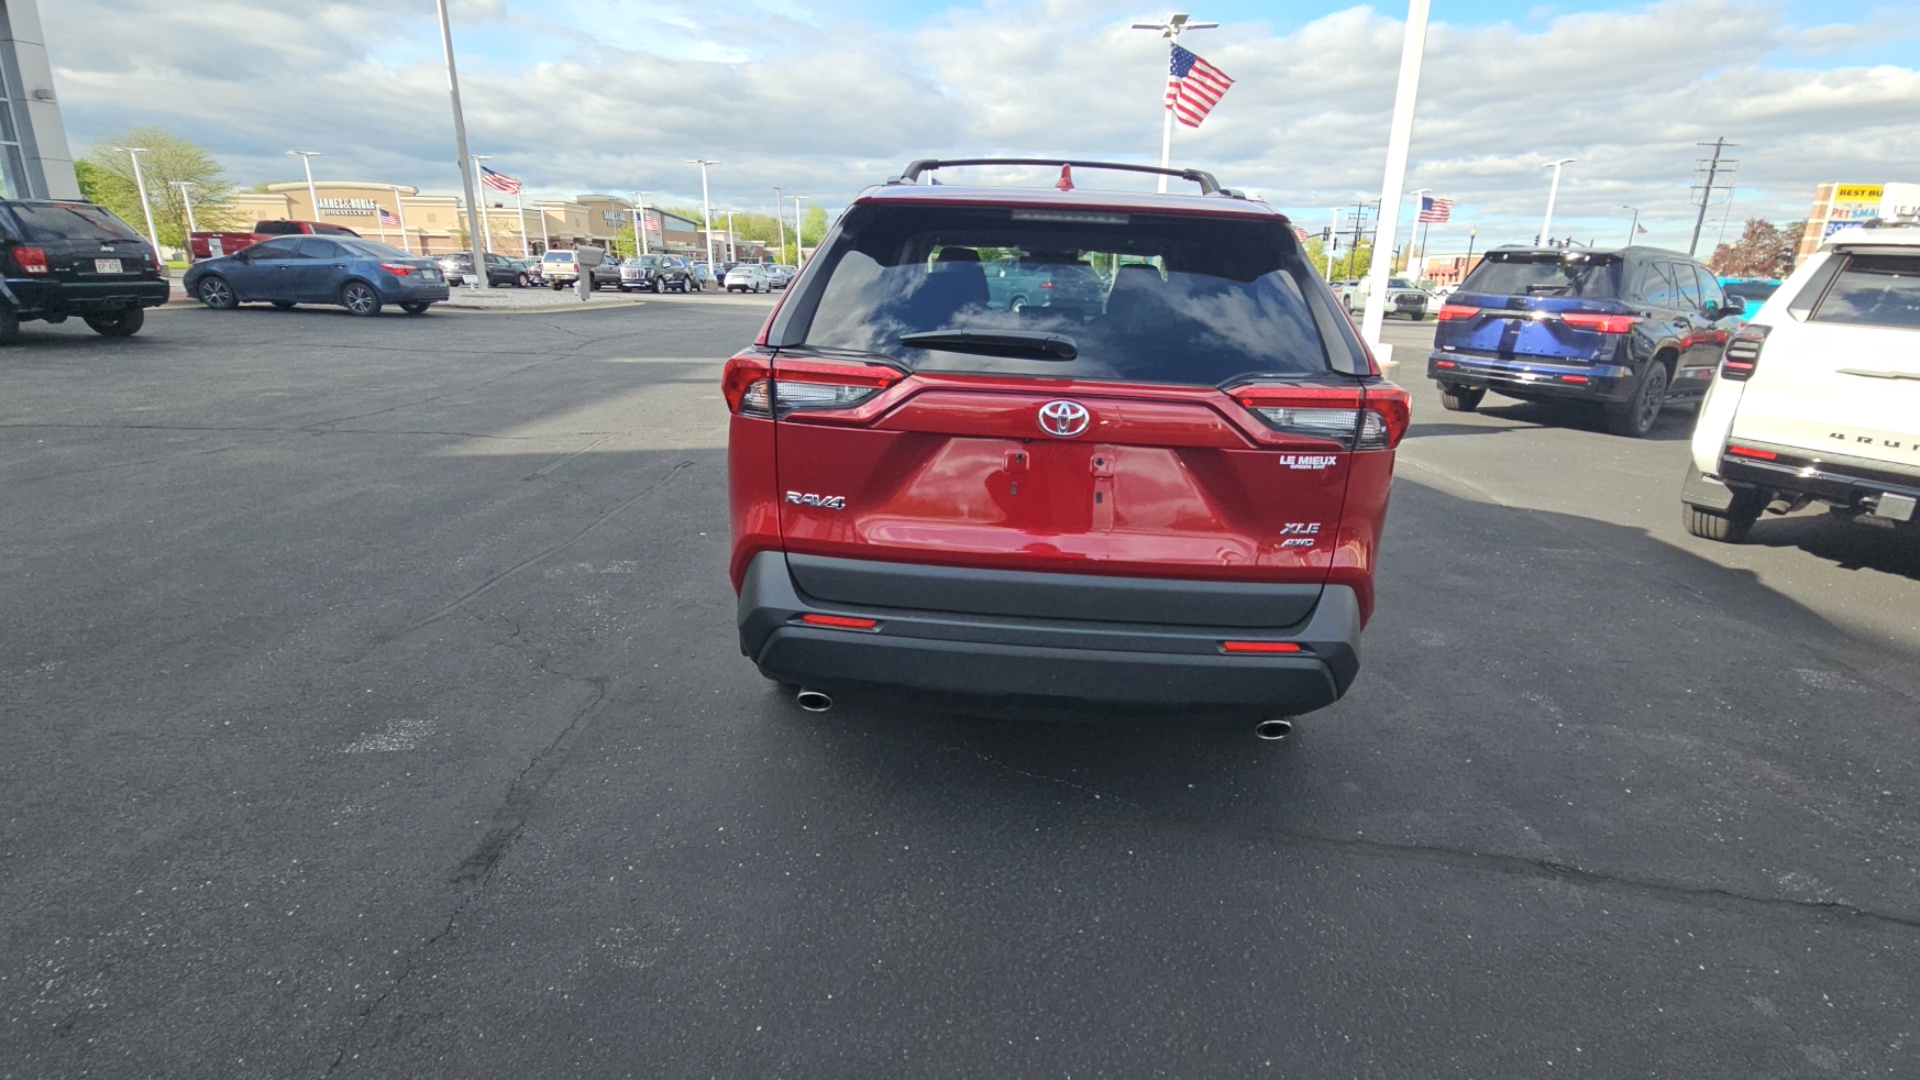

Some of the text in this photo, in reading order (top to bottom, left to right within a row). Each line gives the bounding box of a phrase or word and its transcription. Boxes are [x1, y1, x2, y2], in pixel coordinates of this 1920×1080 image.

[1839, 189, 1866, 197] BEST
[1279, 455, 1337, 465] LE MIEUX
[785, 490, 846, 510] RAV4
[1280, 522, 1321, 535] XLE
[1280, 538, 1315, 548] AWD
